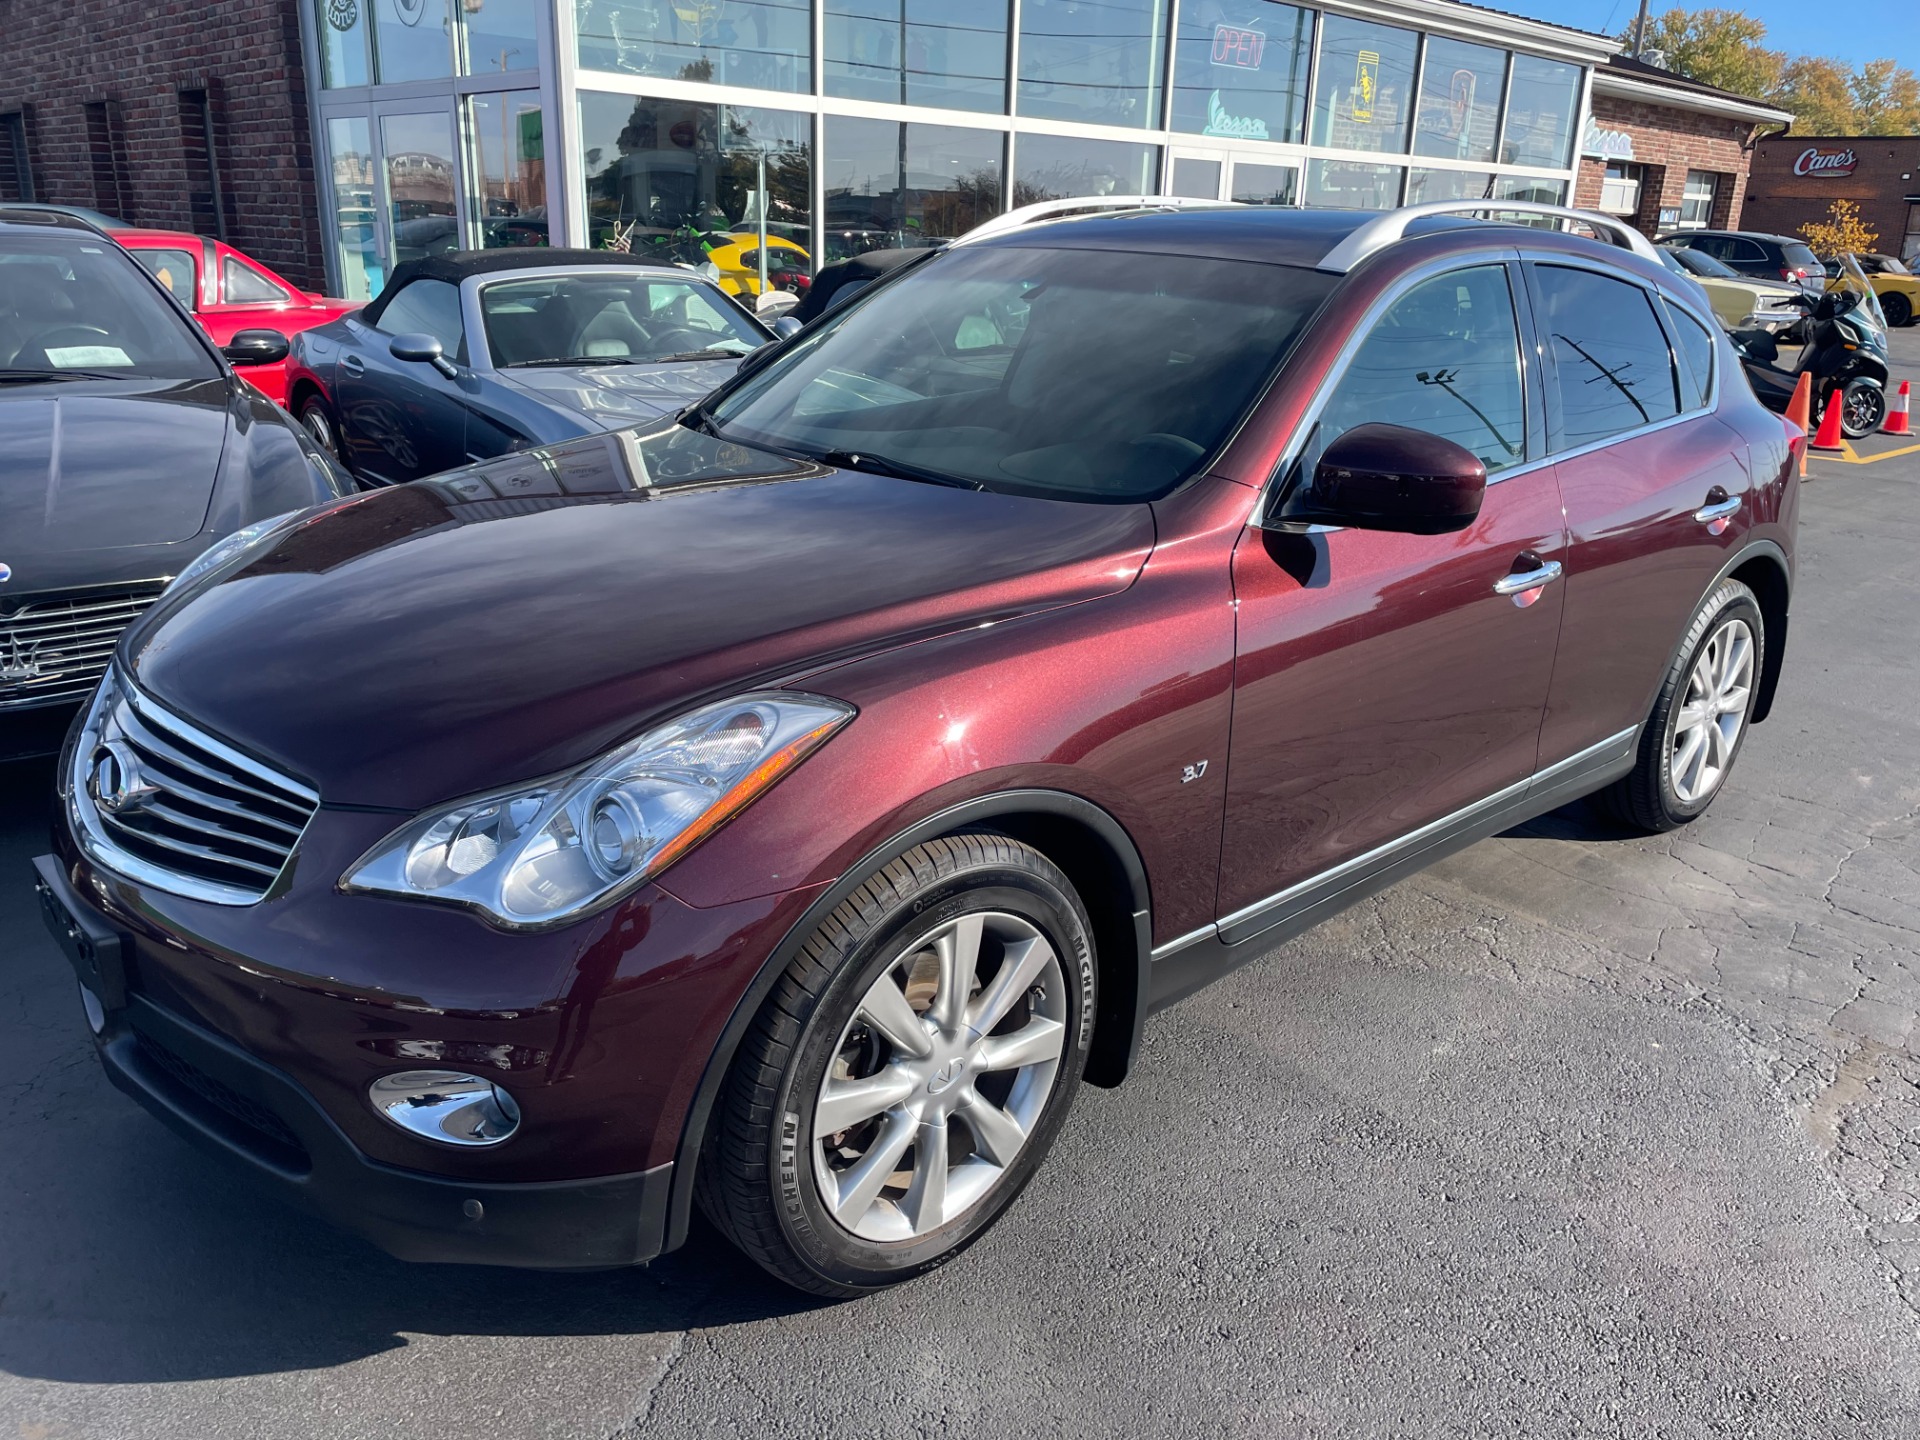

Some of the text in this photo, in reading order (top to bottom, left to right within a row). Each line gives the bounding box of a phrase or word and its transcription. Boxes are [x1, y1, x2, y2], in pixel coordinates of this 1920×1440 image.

[328, 5, 357, 27] LOTUS
[1213, 28, 1263, 67] OPEN
[1203, 89, 1268, 139] Vespa
[1793, 148, 1857, 176] Cane's
[1181, 760, 1208, 783] 3.7
[1073, 934, 1093, 1043] MICHELIN
[780, 1121, 814, 1239] MICHELIN
